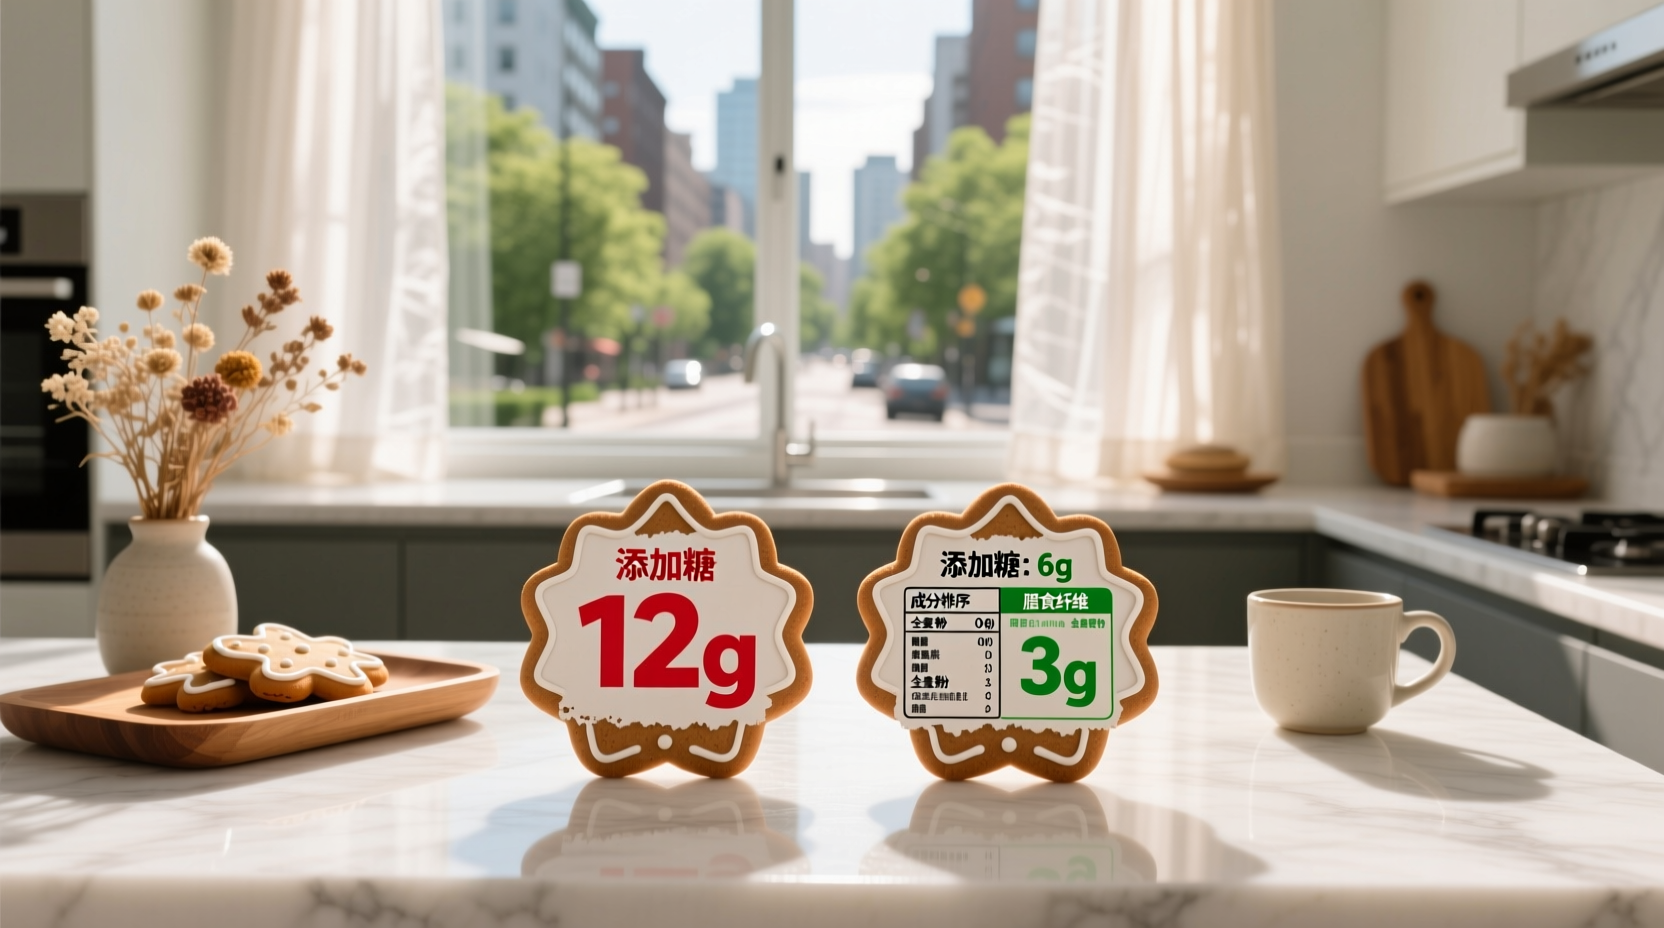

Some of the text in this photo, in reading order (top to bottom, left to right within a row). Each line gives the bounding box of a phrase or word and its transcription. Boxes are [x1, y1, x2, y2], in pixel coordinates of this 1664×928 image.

[616, 547, 716, 581] 添加糖
[1037, 552, 1072, 583] 6g
[911, 591, 971, 609] 成分排序
[578, 592, 756, 709] 12g
[1020, 635, 1096, 707] 3g
